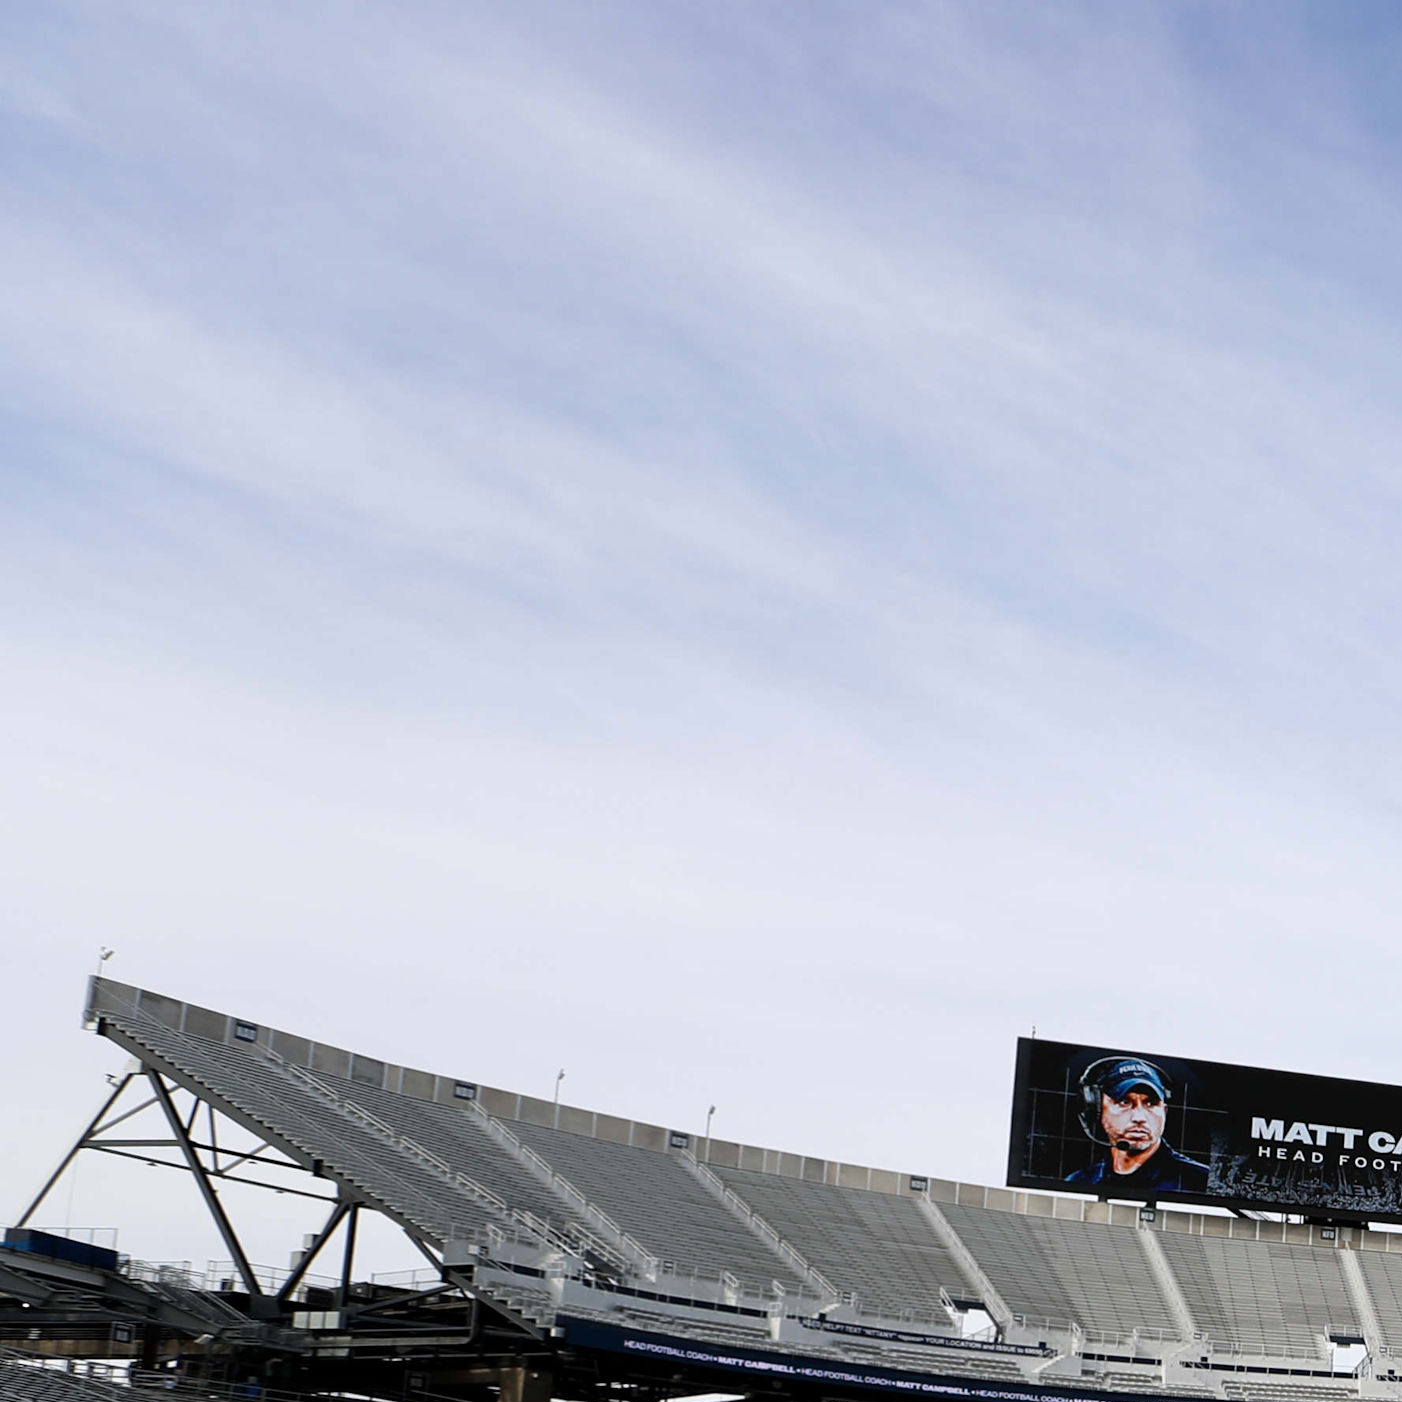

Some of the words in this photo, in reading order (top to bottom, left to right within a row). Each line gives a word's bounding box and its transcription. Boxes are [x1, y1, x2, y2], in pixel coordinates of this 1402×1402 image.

[1251, 1117, 1363, 1150] MATT
[1258, 1146, 1324, 1164] HEAD
[925, 1337, 946, 1346] YOUR
[946, 1339, 981, 1349] LOCATION
[624, 1340, 646, 1350] HEAD
[647, 1342, 685, 1358] FOOTBALL
[686, 1351, 713, 1362] COACH
[718, 1356, 744, 1367] MATT
[744, 1360, 795, 1374] CAMPBELL
[801, 1368, 823, 1378] HEAD
[824, 1370, 863, 1382] FOOTBALL
[864, 1375, 891, 1386] COACH
[896, 1380, 921, 1390] MATT
[922, 1383, 971, 1396] CAMPBELL
[976, 1389, 998, 1398] HEAD
[999, 1391, 1039, 1401] FOOTBALL
